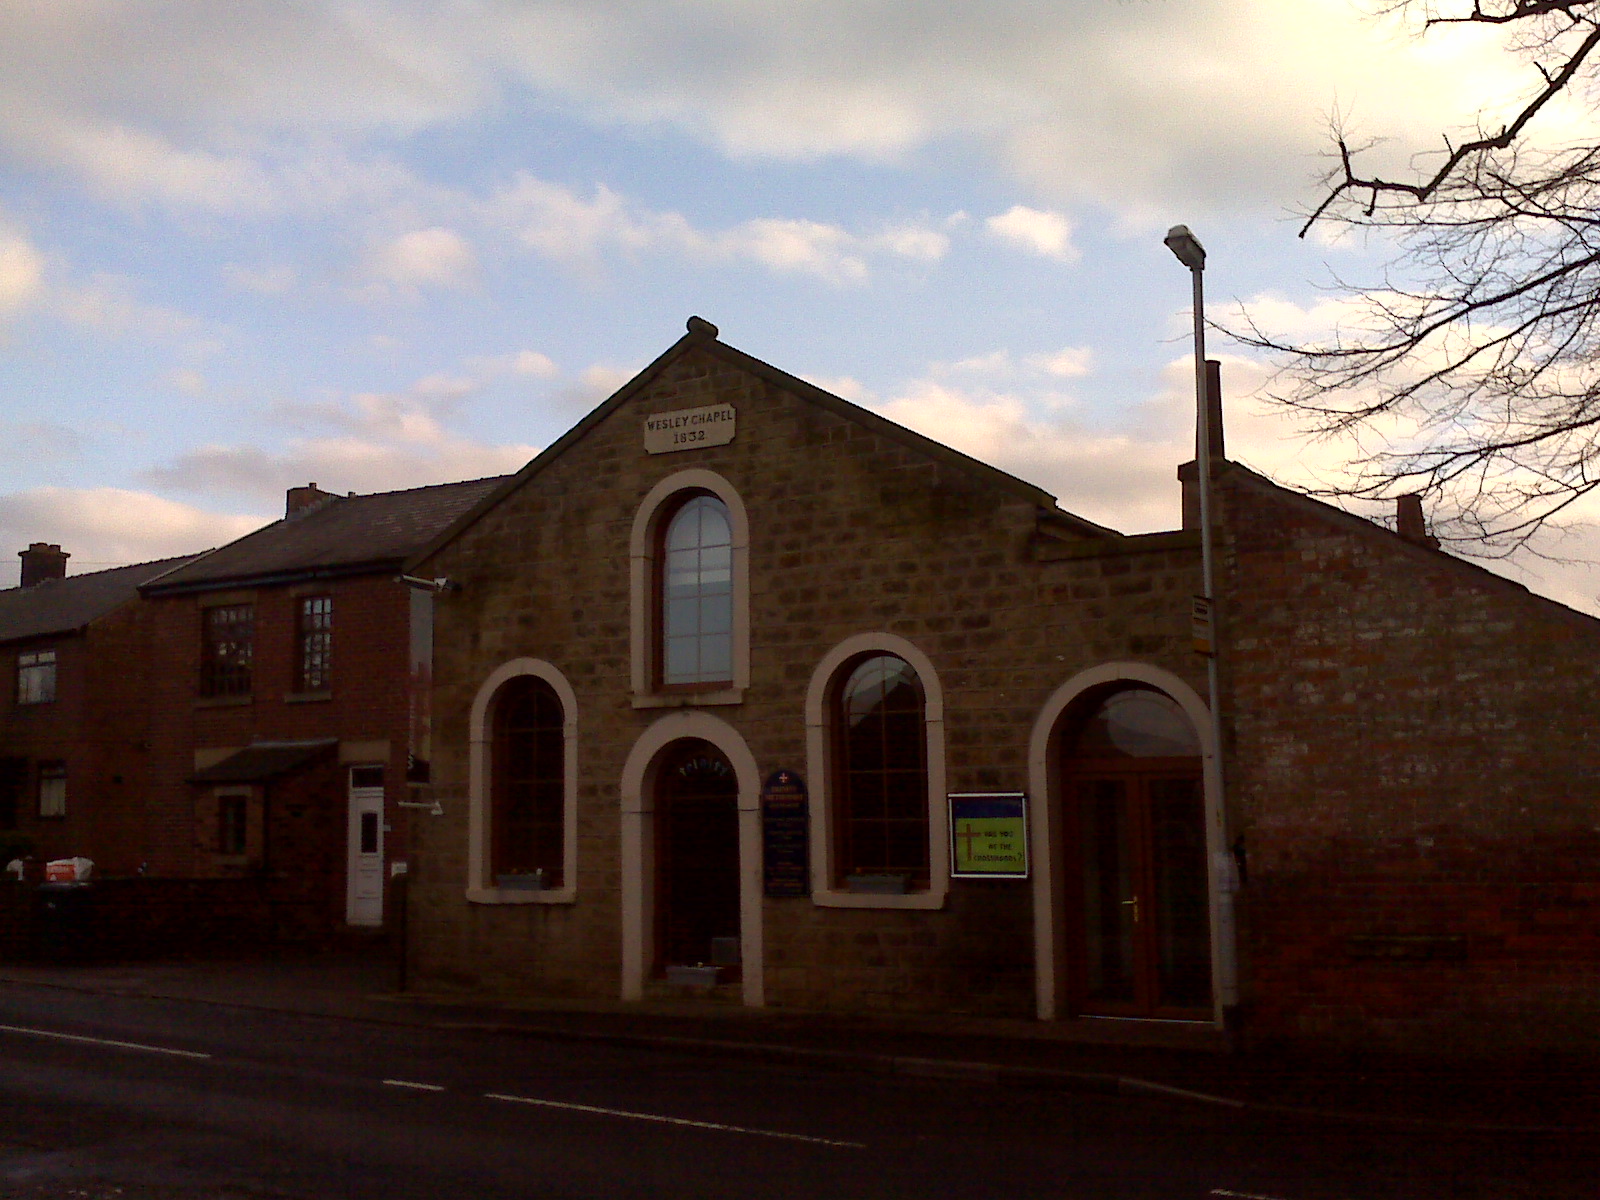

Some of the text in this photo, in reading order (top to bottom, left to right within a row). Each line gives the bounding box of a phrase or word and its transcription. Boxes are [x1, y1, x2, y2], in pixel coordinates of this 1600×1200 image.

[647, 410, 733, 431] WESLEY CHAPEL
[673, 430, 704, 444] 1832
